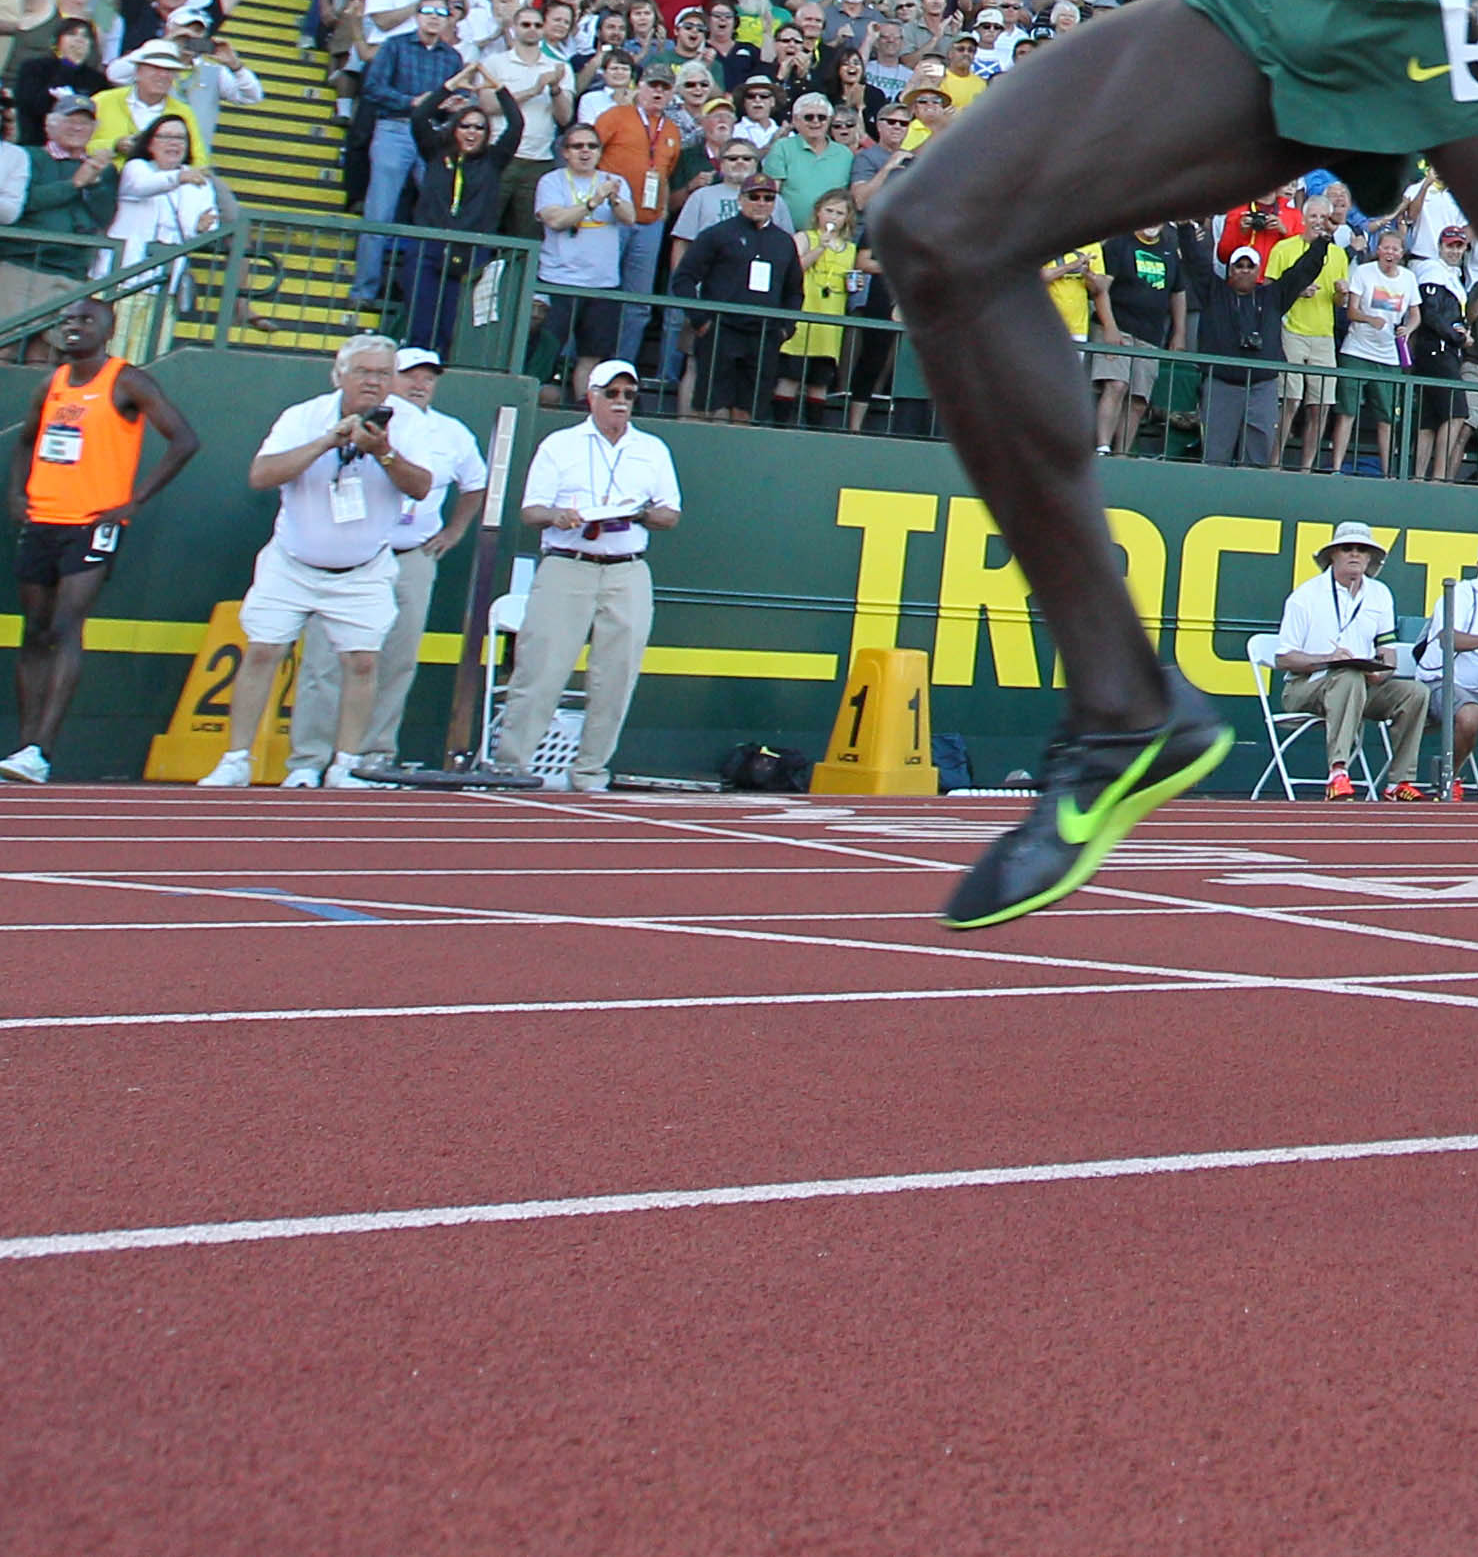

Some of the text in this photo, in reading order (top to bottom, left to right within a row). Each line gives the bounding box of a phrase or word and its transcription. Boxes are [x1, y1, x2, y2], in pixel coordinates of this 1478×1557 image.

[193, 644, 242, 715] 2
[850, 685, 869, 748] 1
[908, 688, 920, 750] 1
